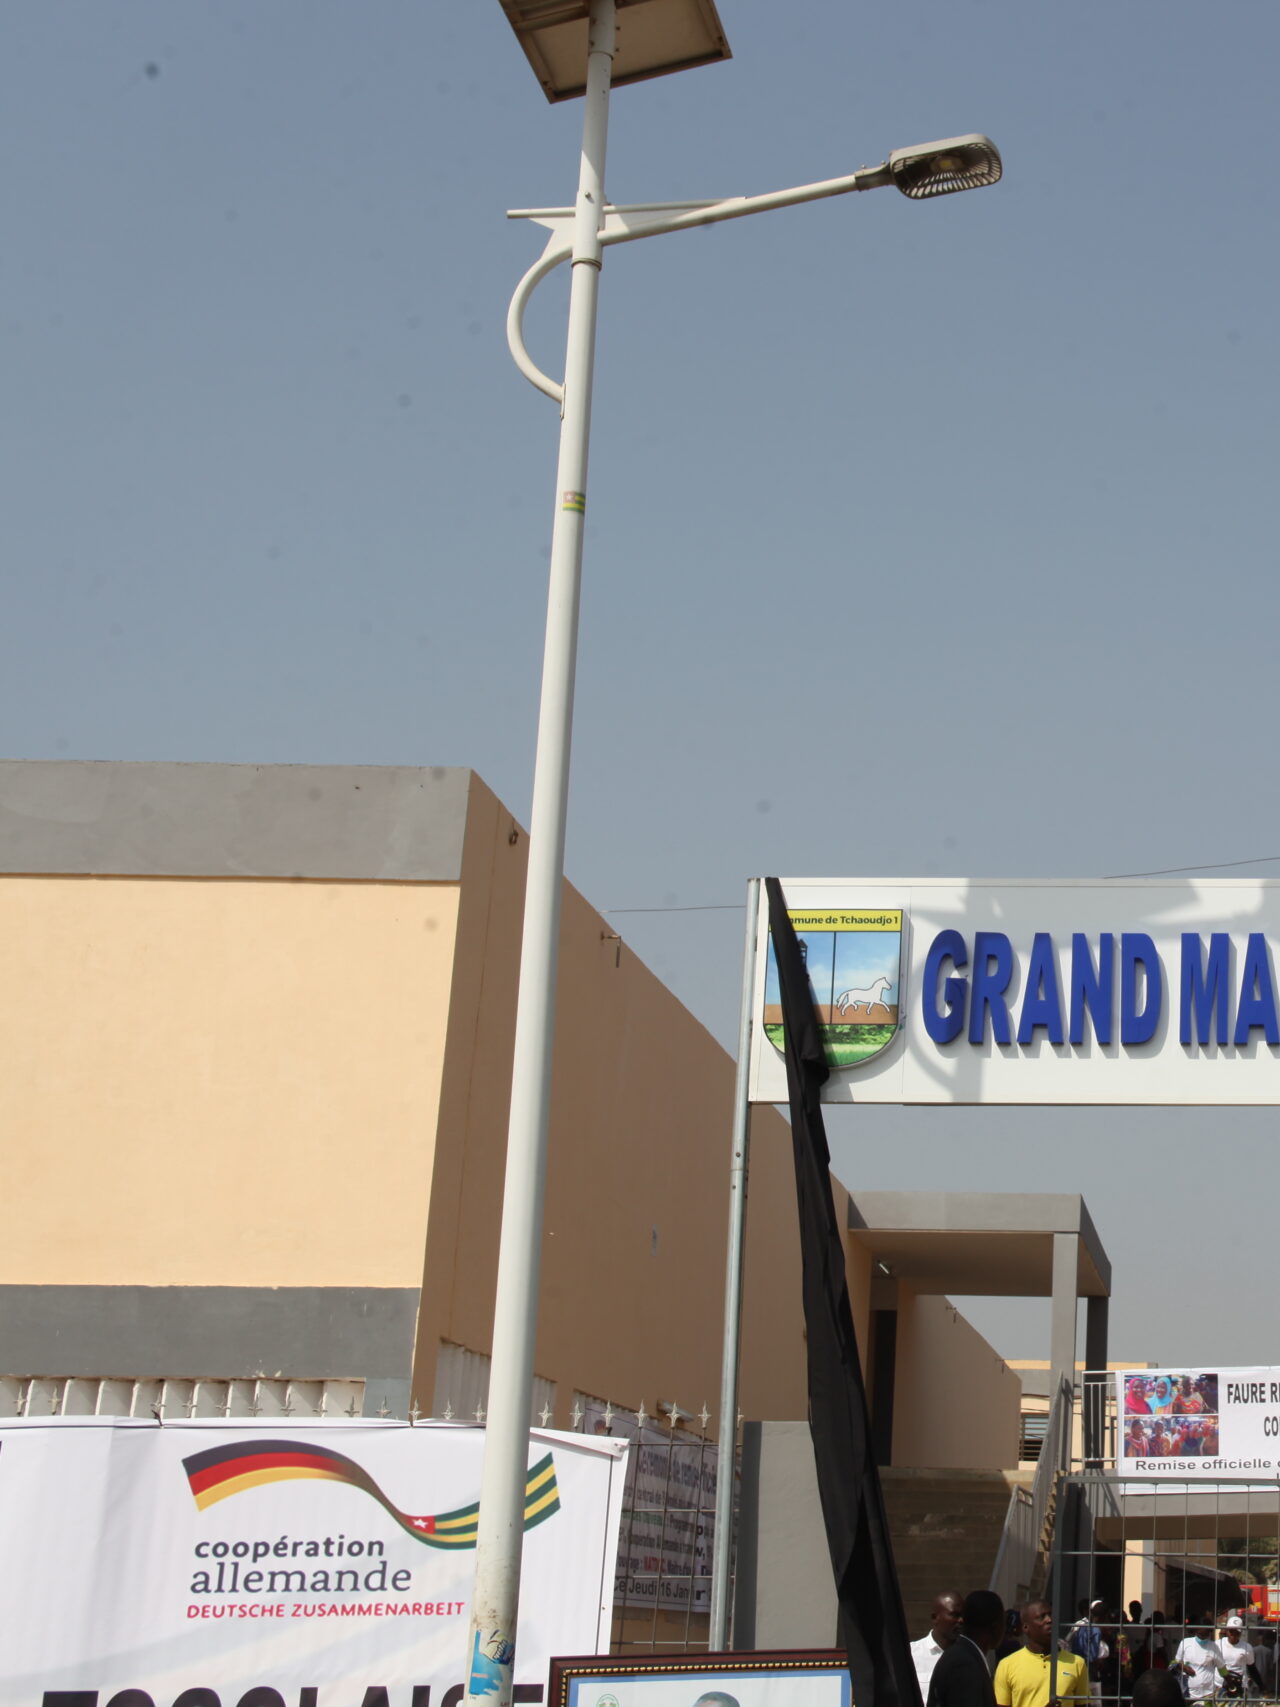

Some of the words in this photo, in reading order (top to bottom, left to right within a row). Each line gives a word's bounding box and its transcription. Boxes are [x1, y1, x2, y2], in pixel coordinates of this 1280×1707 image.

[825, 916, 838, 924] de
[840, 916, 893, 926] Tchaoudjo
[894, 916, 899, 924] 1
[922, 929, 1163, 1045] GRAND
[1227, 1383, 1266, 1404] FAURE
[1135, 1459, 1196, 1471] Remise
[1202, 1458, 1272, 1470] officielle
[194, 1534, 384, 1562] coopération
[190, 1560, 412, 1594] allemande
[660, 1581, 671, 1598] 16
[187, 1603, 285, 1619] DEUTSCHE
[291, 1602, 465, 1618] ZUSAMMENARBEIT
